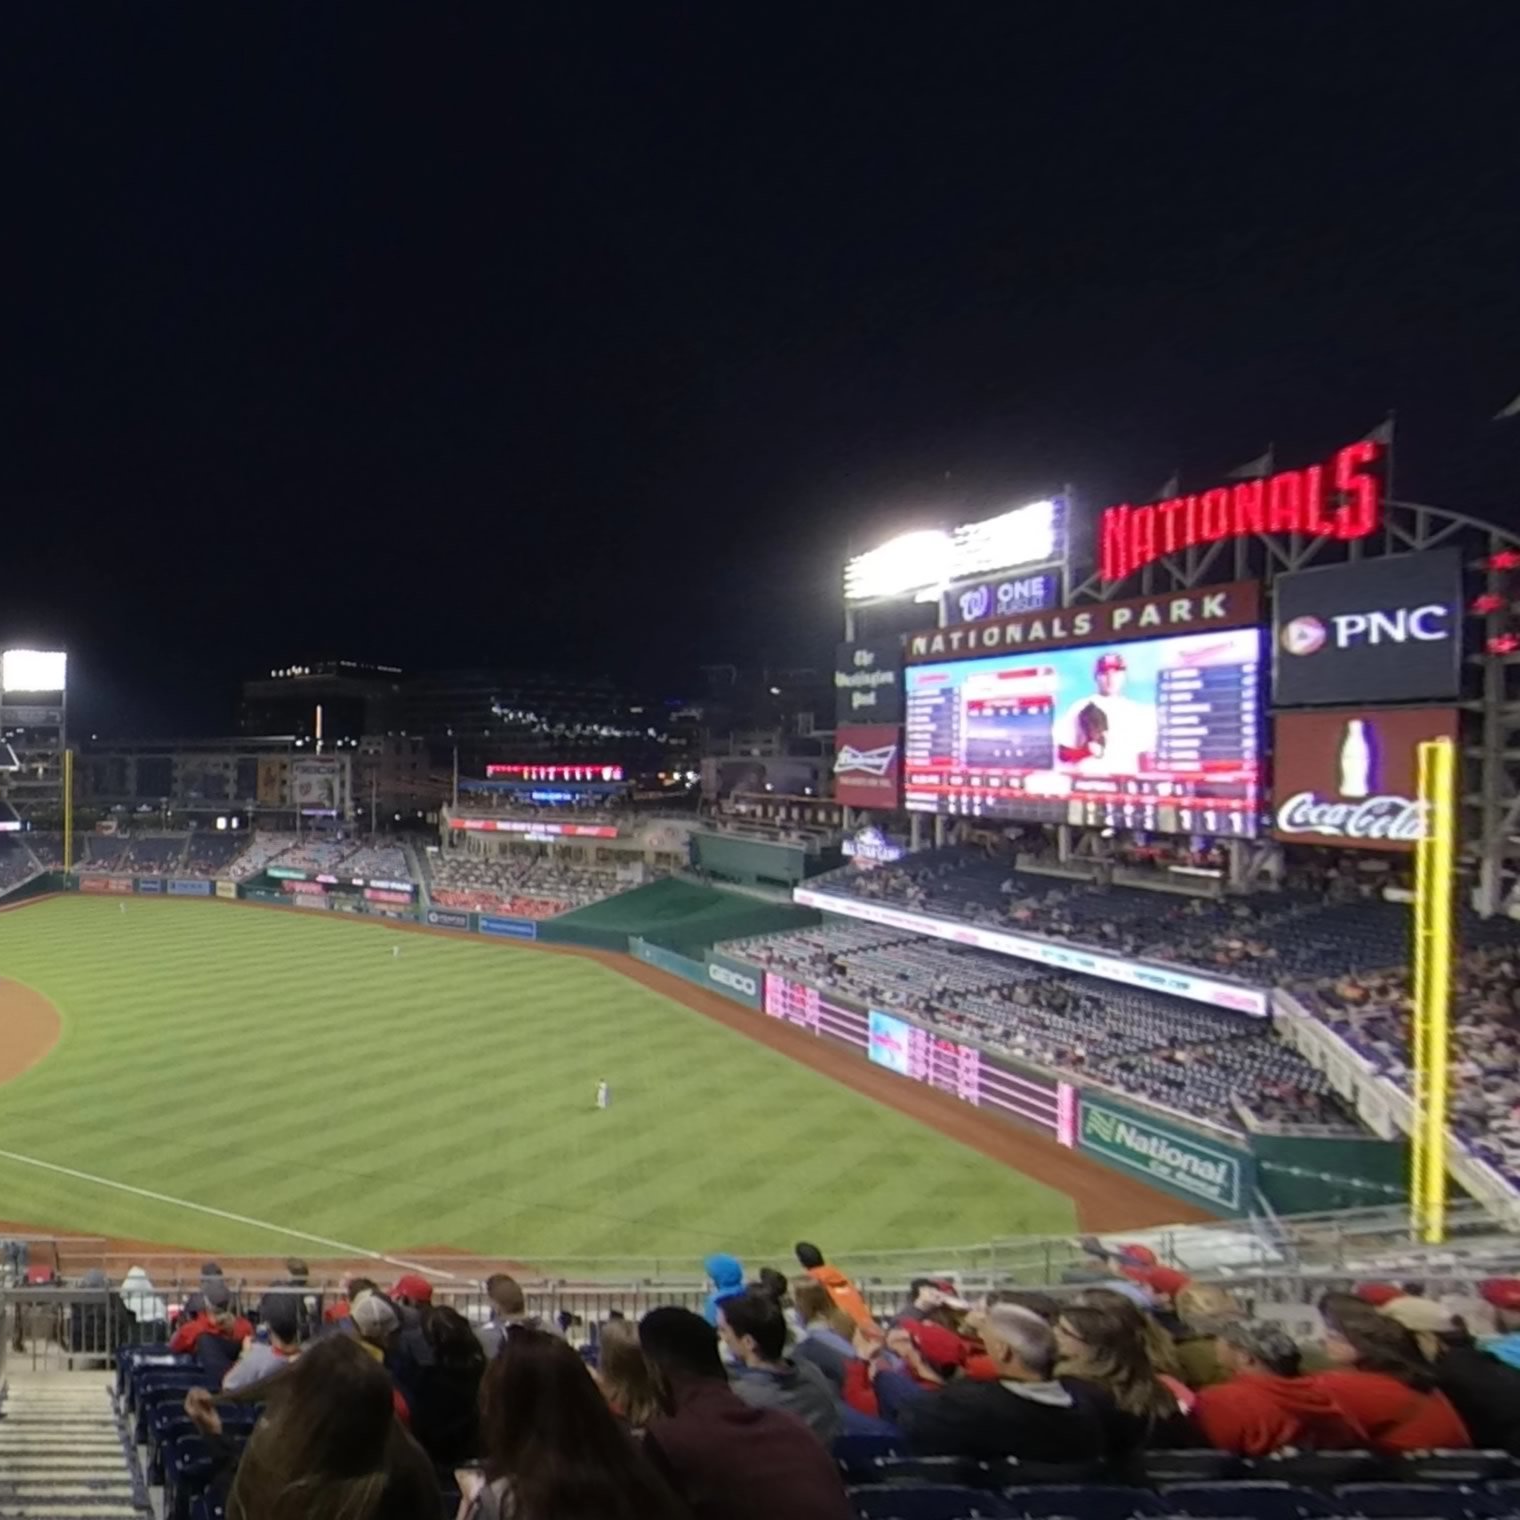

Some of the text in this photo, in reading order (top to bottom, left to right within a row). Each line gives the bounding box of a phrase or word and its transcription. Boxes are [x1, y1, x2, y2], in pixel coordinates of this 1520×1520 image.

[1099, 438, 1378, 581] NATIONALS
[997, 576, 1045, 602] ONE
[912, 593, 1228, 656] NATIONALS PARK
[1332, 605, 1449, 648] PNC
[708, 963, 756, 996] GEICO
[1114, 1121, 1228, 1184] National
